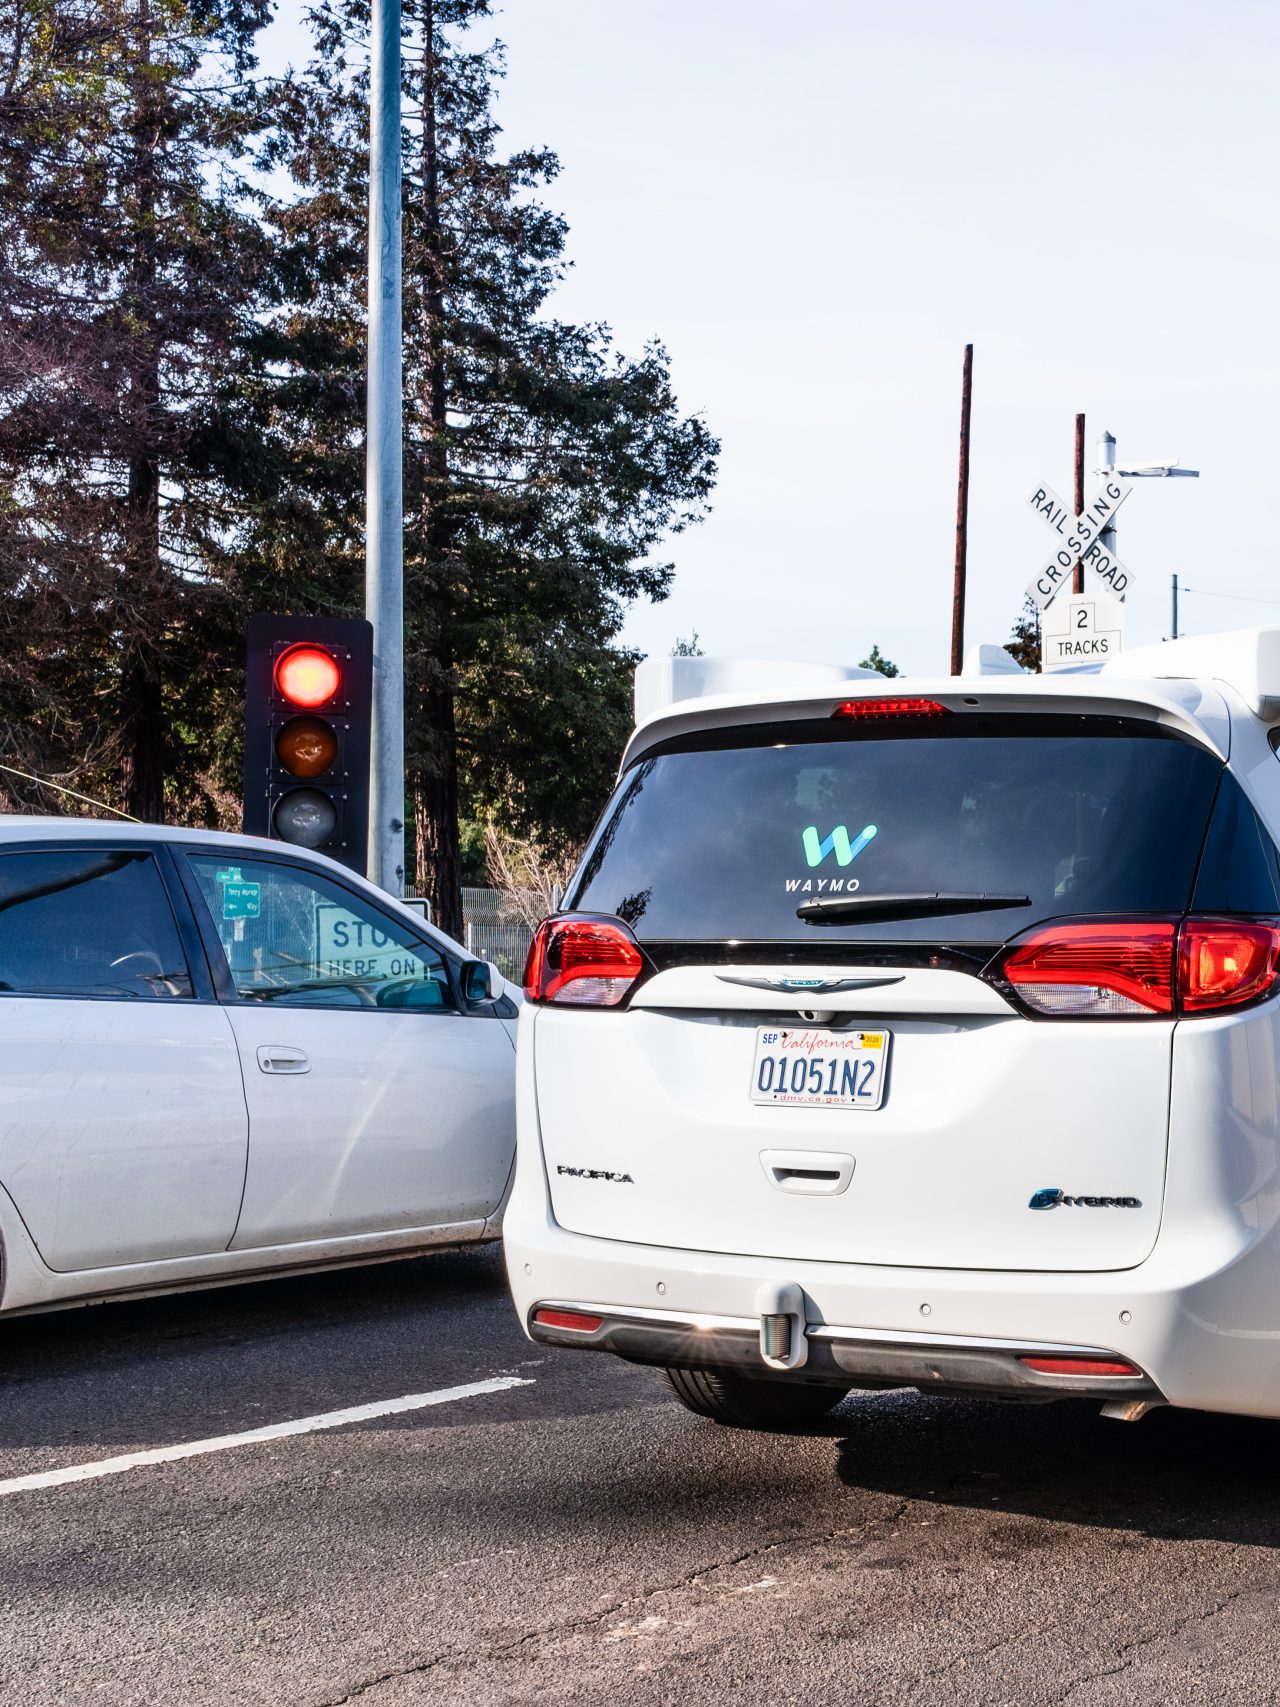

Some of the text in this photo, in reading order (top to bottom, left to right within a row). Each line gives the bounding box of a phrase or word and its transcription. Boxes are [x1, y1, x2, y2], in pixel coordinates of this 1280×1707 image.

[1030, 488, 1128, 592] RAIL ROAD
[1037, 483, 1121, 596] CROSSING
[1077, 610, 1088, 628] 2
[1058, 638, 1109, 656] TRACKS
[785, 879, 860, 892] WAYMO
[333, 920, 400, 948] STO
[329, 958, 416, 977] HERE ON
[762, 1033, 778, 1044] SEP
[781, 1031, 862, 1055] California
[758, 1056, 875, 1096] 01051N2
[780, 1094, 847, 1103] dmv.ca.gov
[557, 1165, 634, 1184] PACIFICA
